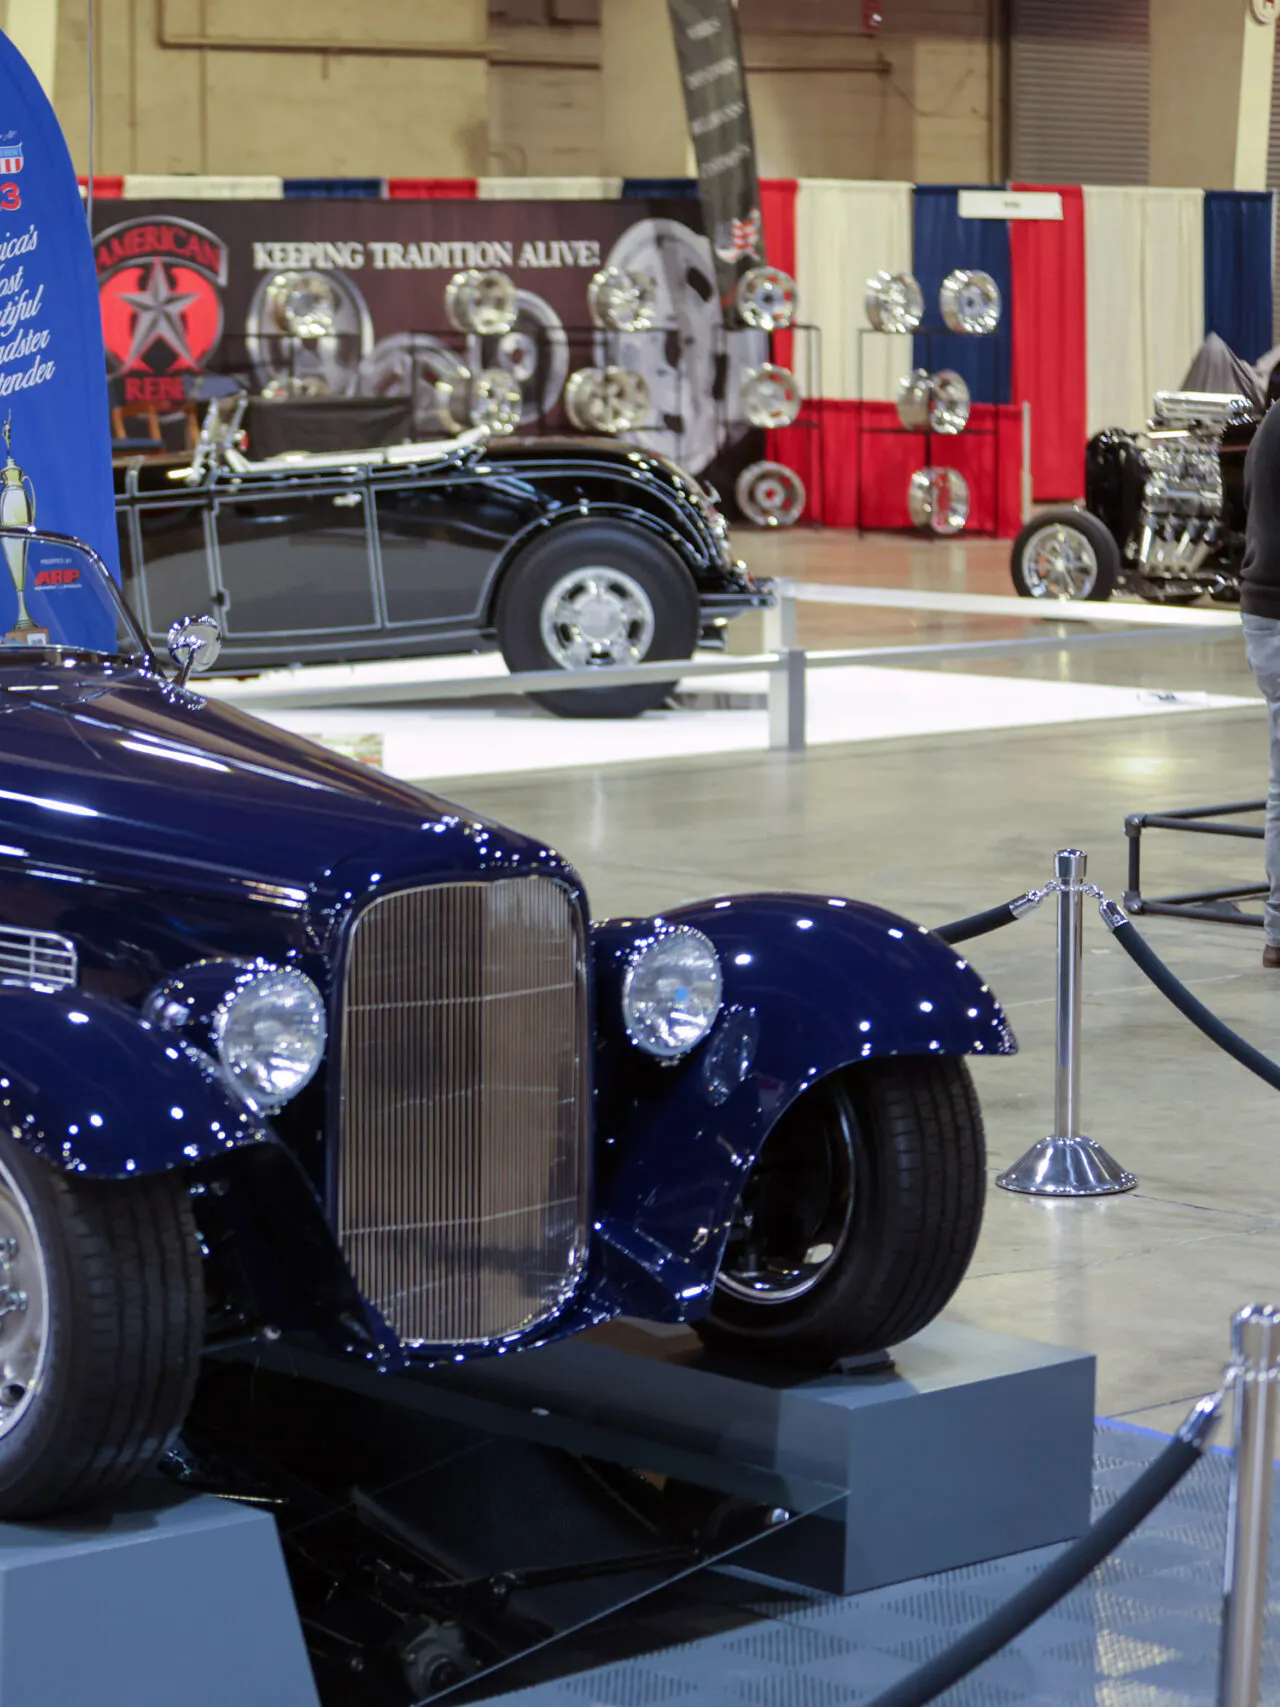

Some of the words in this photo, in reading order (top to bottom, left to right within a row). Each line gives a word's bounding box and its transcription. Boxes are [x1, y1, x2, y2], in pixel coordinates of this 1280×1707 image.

[96, 225, 221, 273] AMERICAN
[253, 241, 365, 270] KEEPING
[367, 241, 514, 270] TRADITION
[517, 240, 602, 268] ALIVE!
[34, 569, 80, 586] ARP
